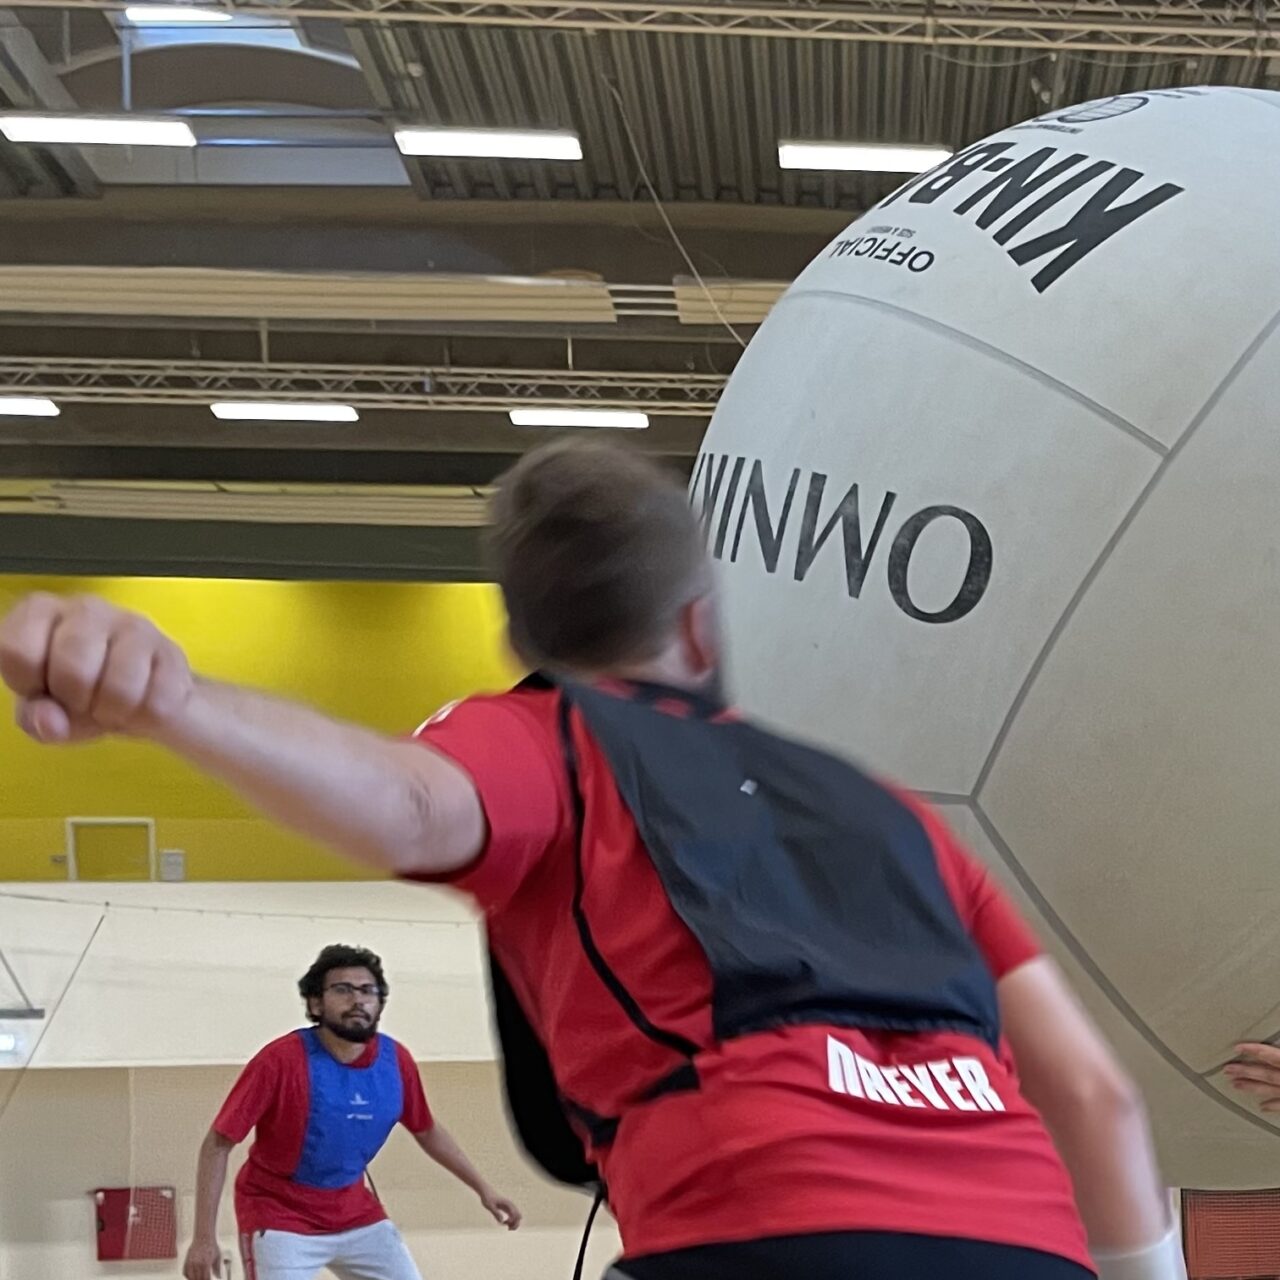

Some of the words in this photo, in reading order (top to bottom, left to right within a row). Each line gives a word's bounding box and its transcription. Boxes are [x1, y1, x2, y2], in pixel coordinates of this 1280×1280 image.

[831, 235, 935, 274] OFFICIAL
[878, 141, 1185, 294] KIN-B
[826, 1033, 1006, 1112] DREYER
